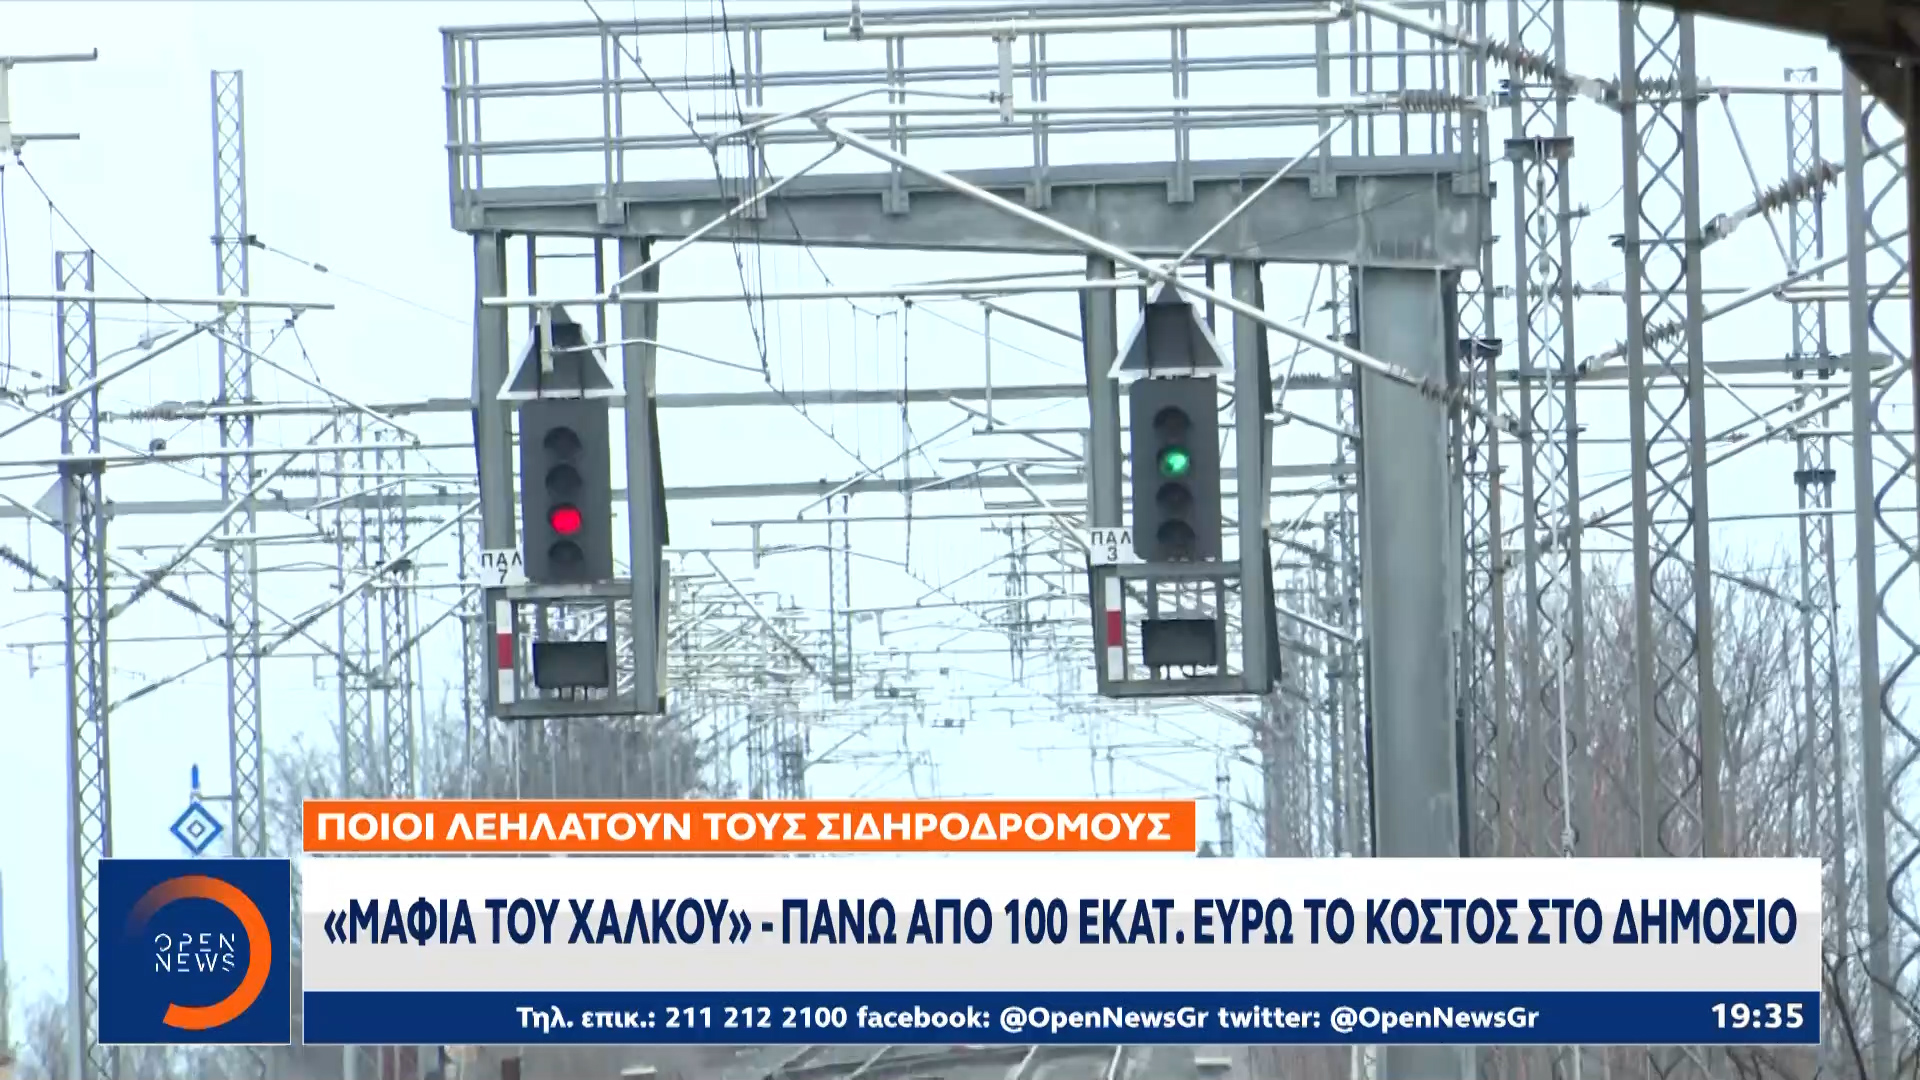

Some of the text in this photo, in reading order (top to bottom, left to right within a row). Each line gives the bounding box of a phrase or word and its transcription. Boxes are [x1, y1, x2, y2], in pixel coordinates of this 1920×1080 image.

[1091, 530, 1131, 545] ΠΑΛ
[481, 552, 522, 567] ΠΑΛ
[1107, 547, 1118, 562] 3
[498, 569, 508, 584] 7
